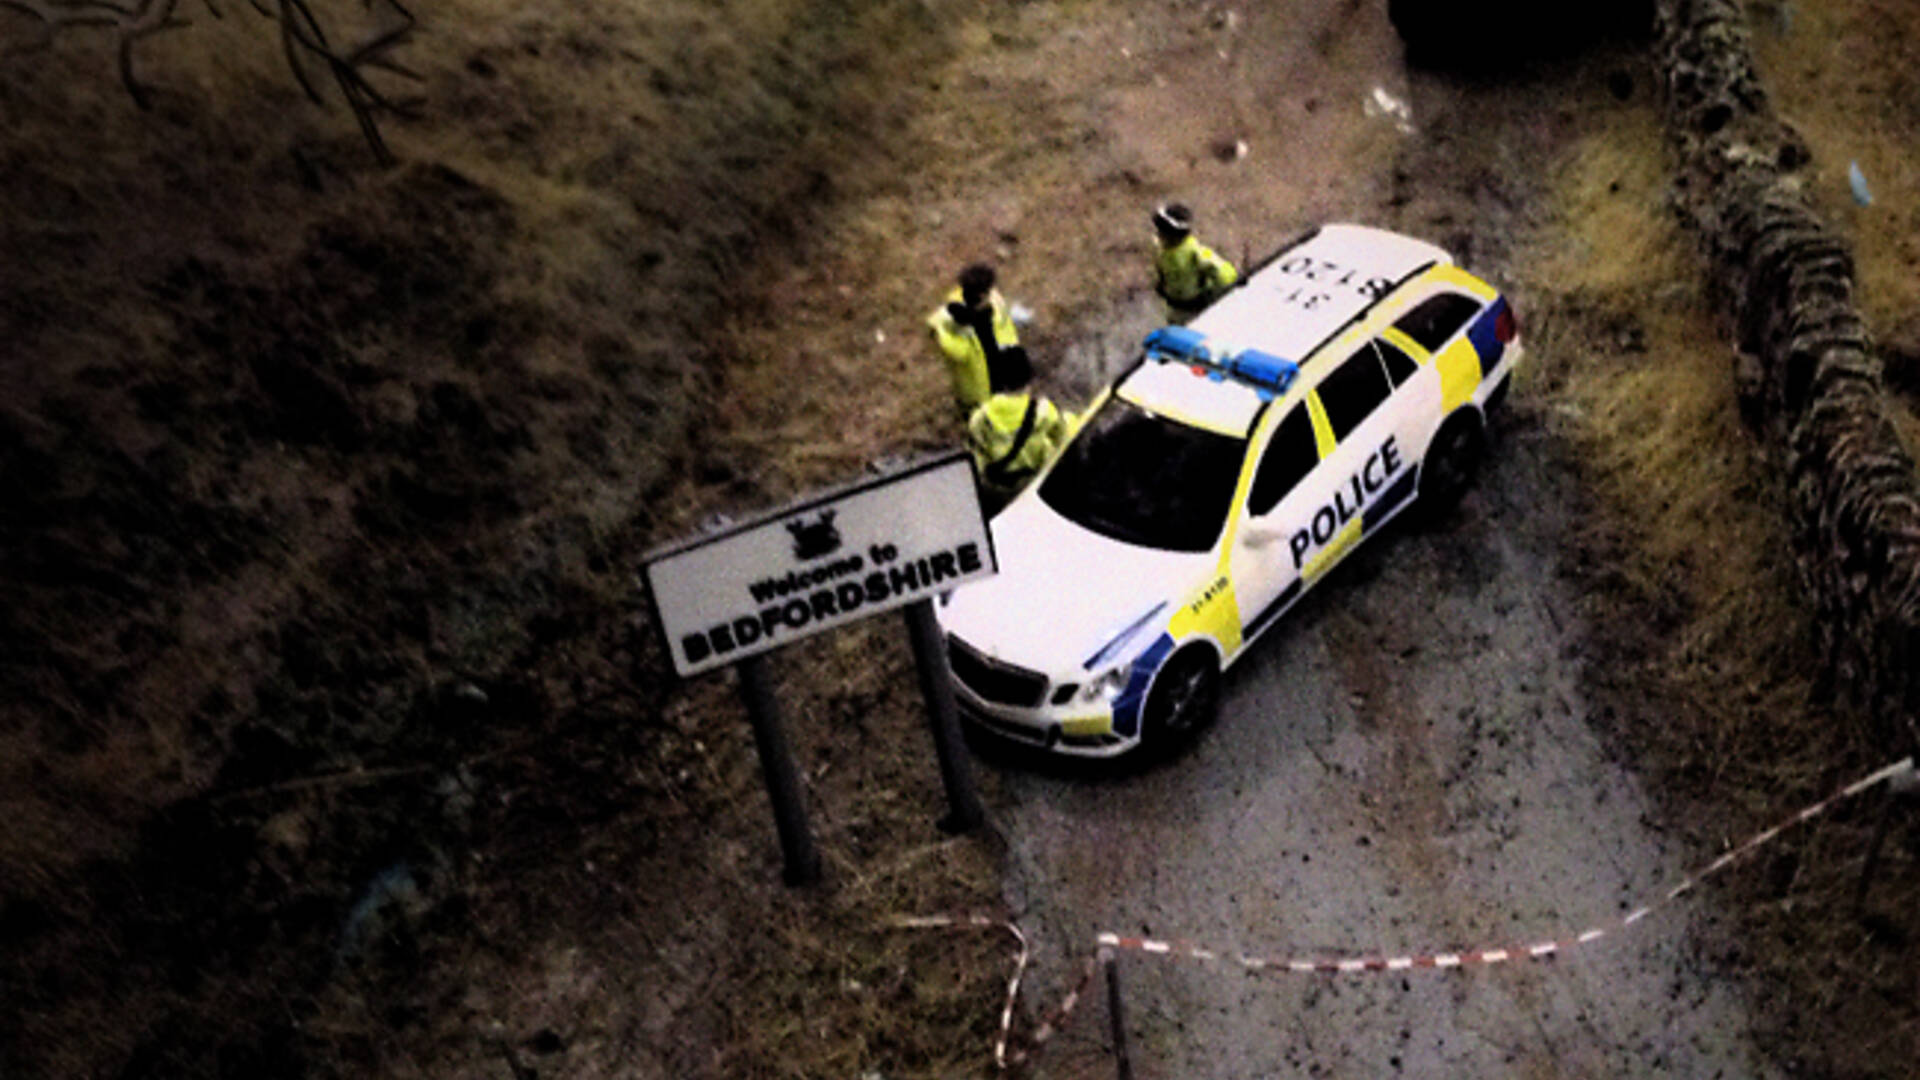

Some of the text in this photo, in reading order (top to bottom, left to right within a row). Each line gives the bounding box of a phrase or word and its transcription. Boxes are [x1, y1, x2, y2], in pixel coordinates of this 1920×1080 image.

[1290, 434, 1401, 569] POLICE
[681, 542, 982, 664] BEDFORDSHIRE
[748, 543, 898, 604] Welcome to
